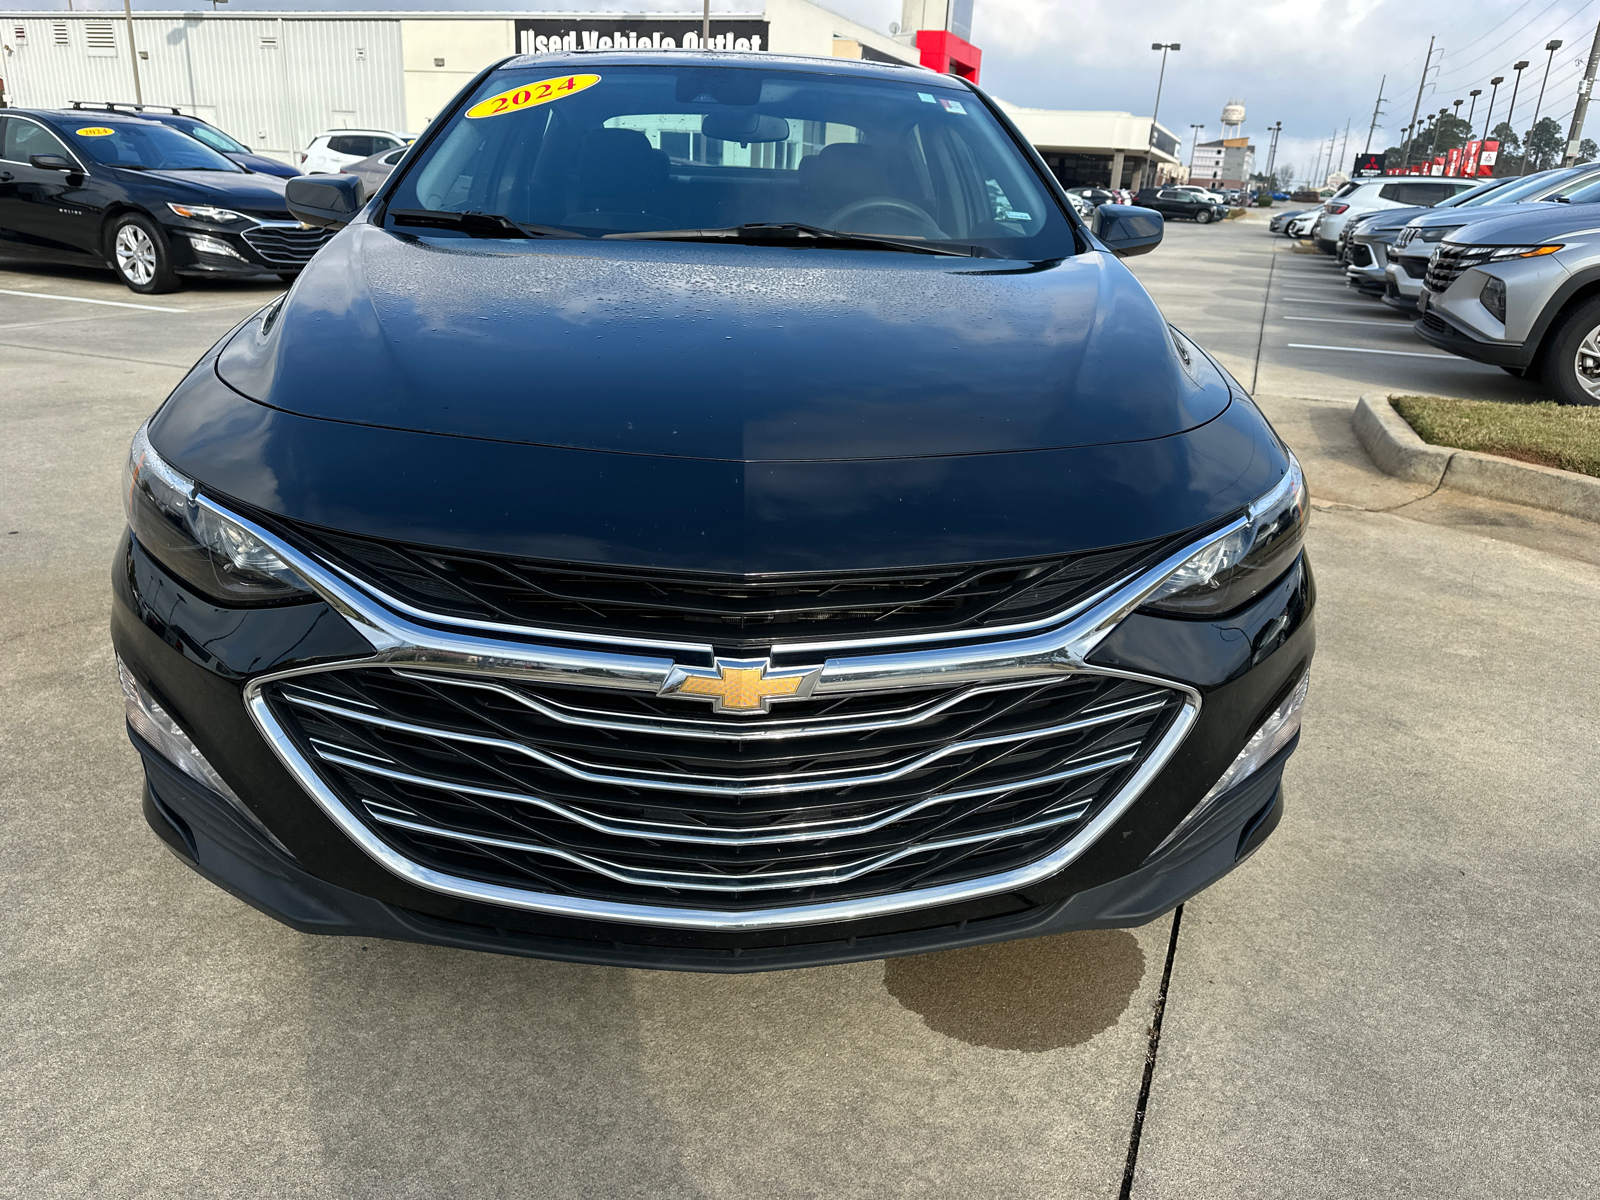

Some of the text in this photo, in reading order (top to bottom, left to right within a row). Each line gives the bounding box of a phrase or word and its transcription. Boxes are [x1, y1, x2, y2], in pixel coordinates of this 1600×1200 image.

[520, 30, 761, 54] Used Vehicle Outlet
[490, 77, 577, 114] 2024
